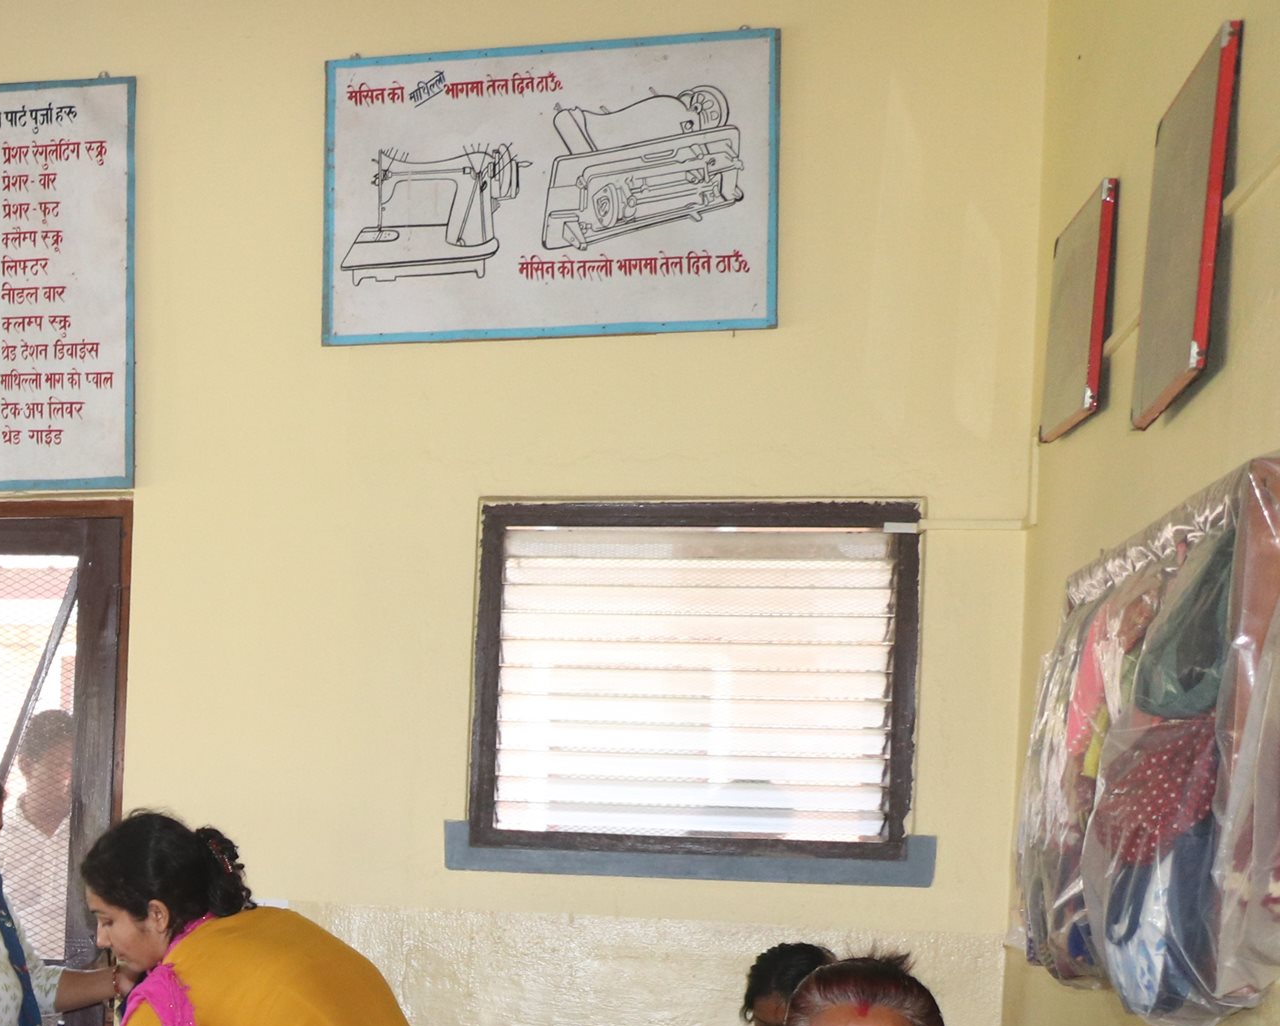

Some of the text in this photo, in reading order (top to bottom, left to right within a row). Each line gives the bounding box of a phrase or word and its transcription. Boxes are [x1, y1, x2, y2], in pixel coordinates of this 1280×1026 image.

[387, 81, 404, 104] को
[444, 80, 483, 99] भागमा
[486, 74, 509, 98] तेल
[512, 71, 535, 98] दिने
[2, 141, 30, 165] प्रेशर
[519, 255, 556, 281] मेसिन
[558, 254, 574, 279] को
[616, 257, 658, 277] भागमा
[660, 251, 683, 276] तेल
[686, 250, 712, 276] दिने
[44, 373, 64, 391] भाग
[67, 368, 81, 390] को
